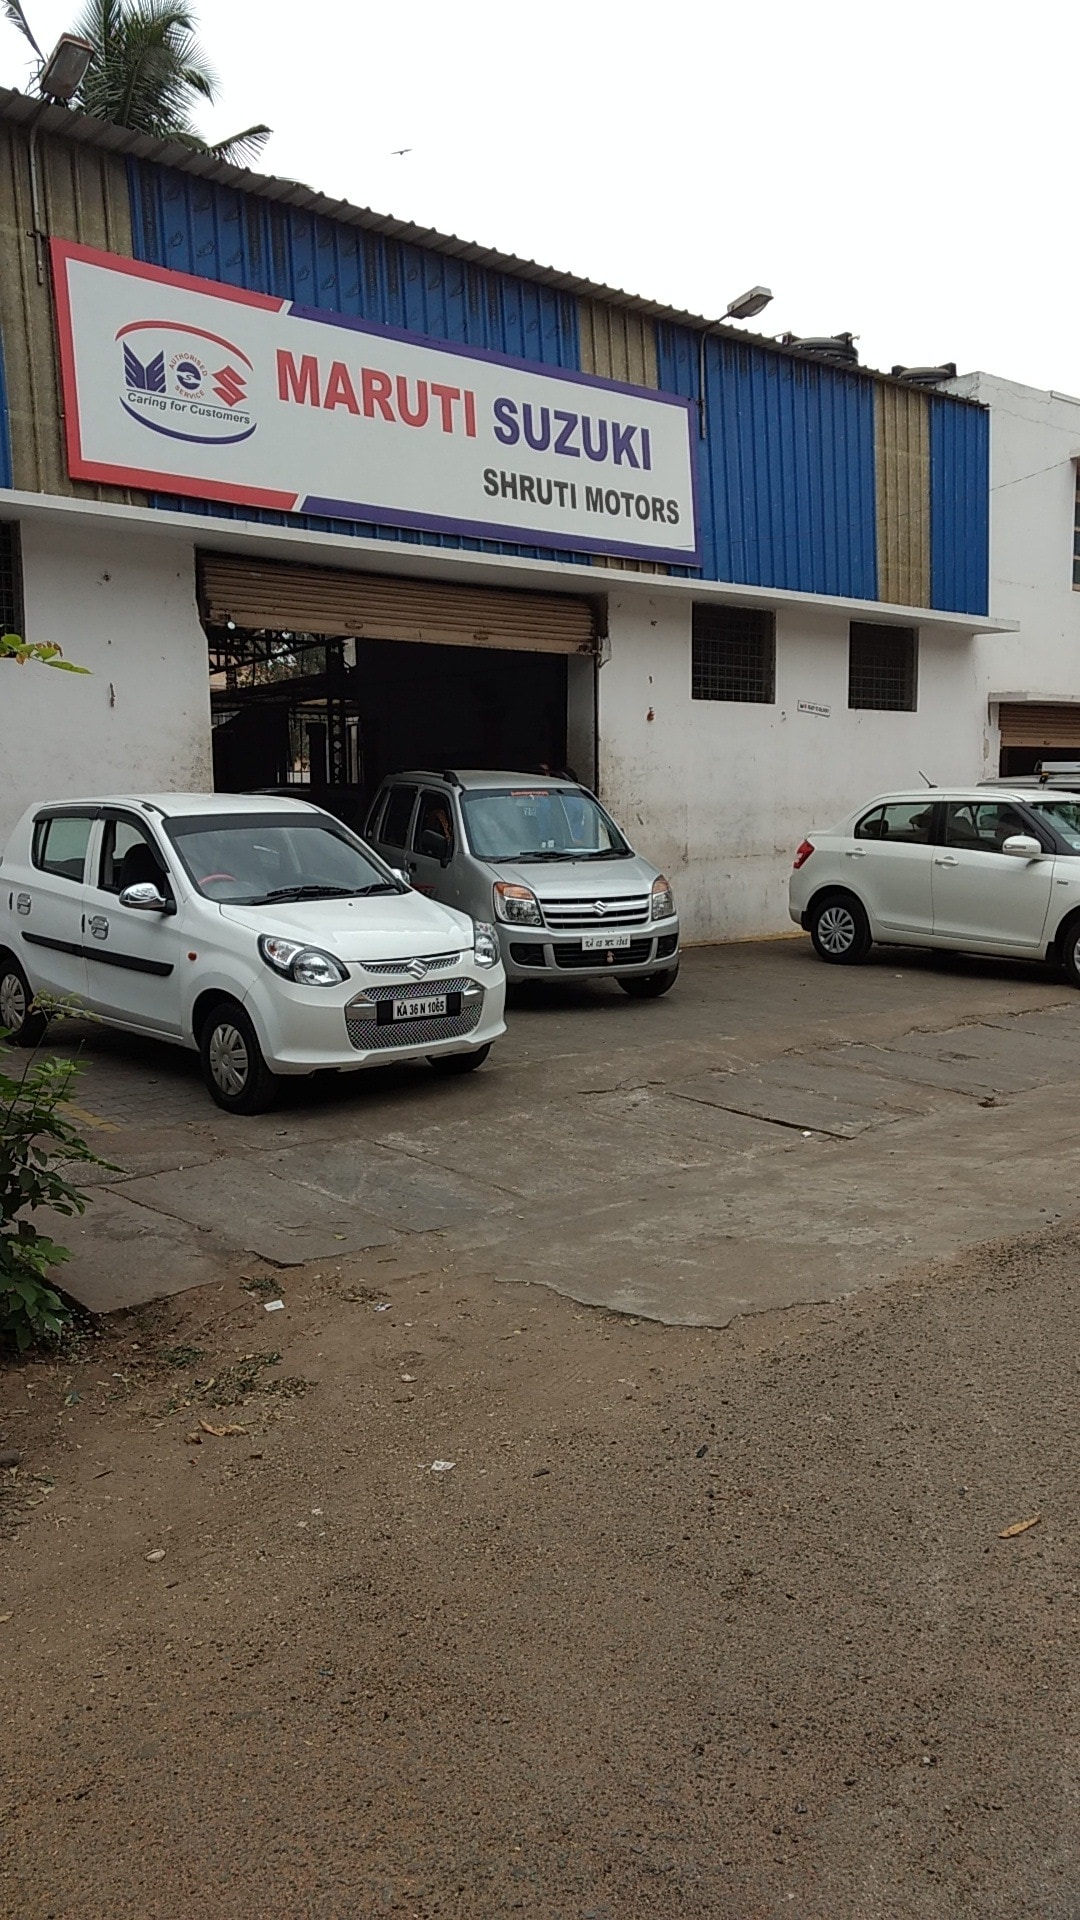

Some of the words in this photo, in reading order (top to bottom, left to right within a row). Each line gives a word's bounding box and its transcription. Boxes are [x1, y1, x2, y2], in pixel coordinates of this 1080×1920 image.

[168, 353, 208, 377] AUTHORISED
[175, 385, 205, 399] SERVICE
[127, 392, 167, 410] Caring
[170, 400, 187, 413] for
[189, 404, 250, 424] Customers
[276, 348, 477, 438] MARUTI
[493, 397, 652, 471] SUZUKI
[483, 468, 577, 510] SHRUTI
[585, 486, 680, 525] MOTORS
[397, 1002, 407, 1016] KA
[409, 1003, 419, 1015] 36
[420, 1002, 426, 1014] N
[427, 1000, 445, 1013] 1065
